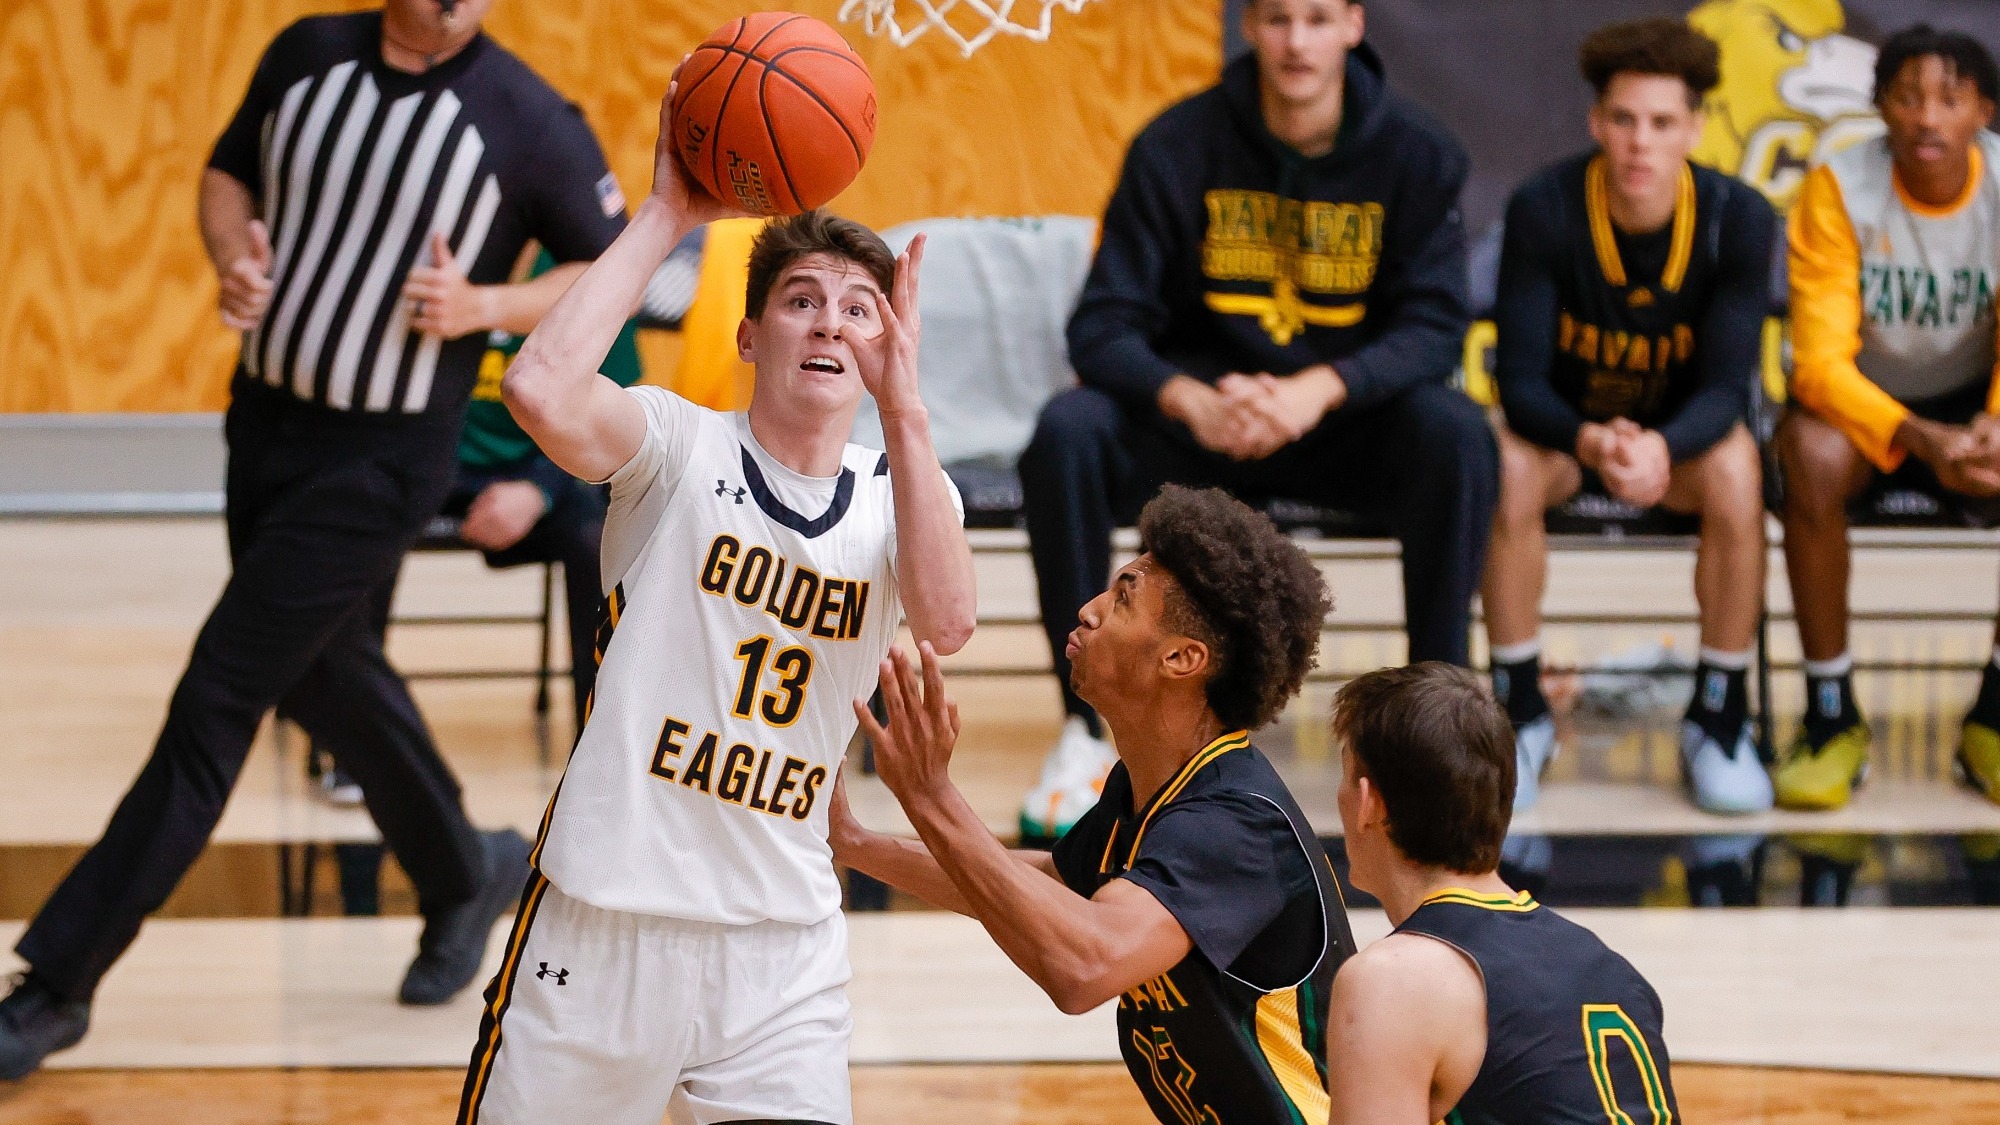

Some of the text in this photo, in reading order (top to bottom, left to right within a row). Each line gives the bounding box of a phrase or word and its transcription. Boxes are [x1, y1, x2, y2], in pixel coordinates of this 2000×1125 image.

[698, 533, 870, 640] GOLDEN
[731, 633, 815, 728] 13
[648, 716, 828, 821] EAGLES
